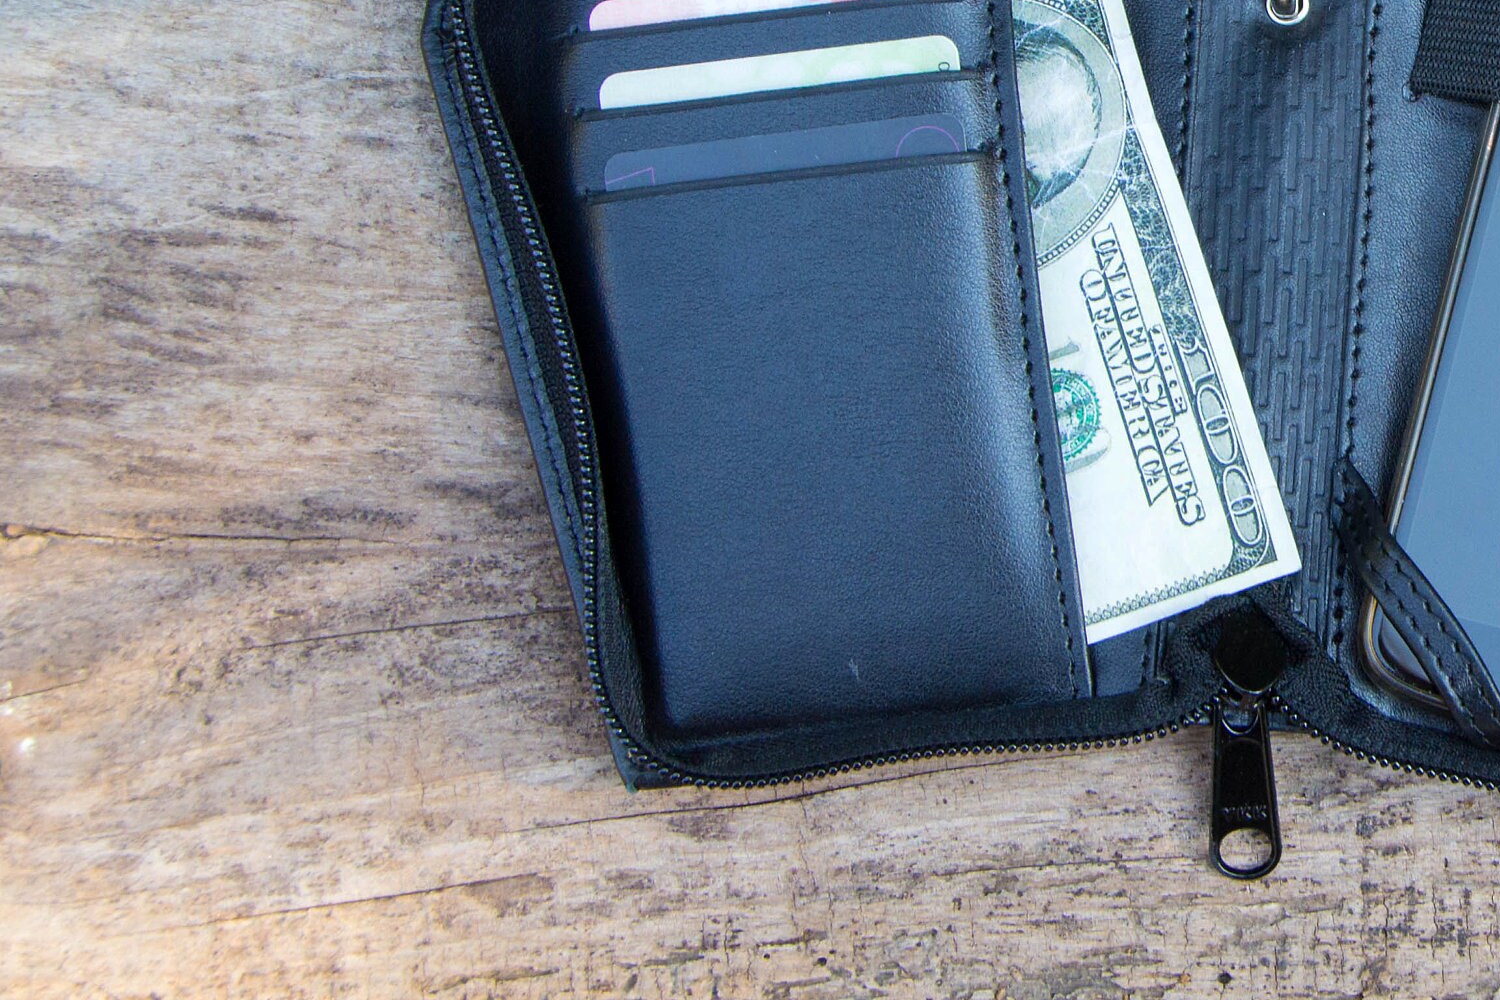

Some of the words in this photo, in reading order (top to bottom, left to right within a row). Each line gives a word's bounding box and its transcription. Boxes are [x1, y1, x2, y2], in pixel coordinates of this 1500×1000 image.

[1079, 268, 1116, 325] OF
[1091, 222, 1158, 383] UNITED
[1136, 374, 1206, 527] STATES
[1093, 322, 1169, 507] AMERICA
[1181, 340, 1262, 547] 100
